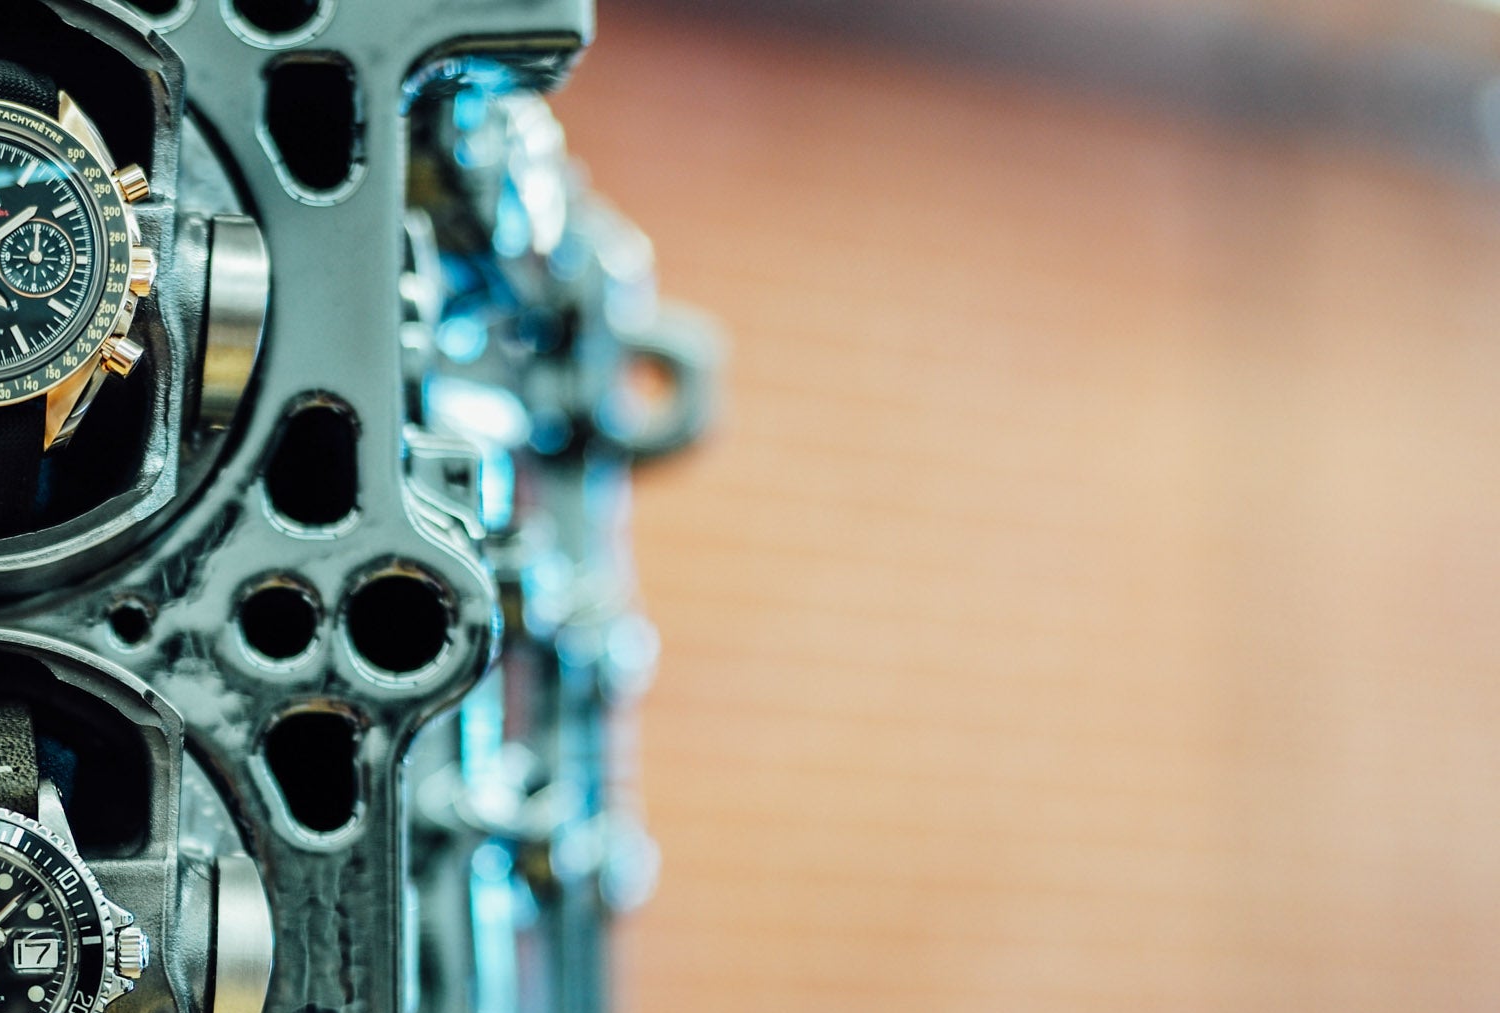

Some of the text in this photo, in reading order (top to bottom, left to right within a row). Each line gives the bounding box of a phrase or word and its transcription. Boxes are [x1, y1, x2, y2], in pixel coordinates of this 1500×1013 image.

[67, 148, 85, 159] 500
[83, 168, 101, 178] 400
[93, 184, 111, 195] 350
[103, 206, 121, 217] 300
[109, 232, 127, 242] 260
[60, 254, 66, 265] 3
[109, 263, 127, 274] 240
[106, 283, 124, 293] 220
[100, 303, 116, 314] 200
[95, 317, 110, 327] 190
[87, 329, 103, 339] 180
[76, 342, 92, 353] 170
[63, 356, 78, 366] 160
[45, 368, 61, 379] 150
[23, 380, 39, 390] 140
[59, 866, 81, 890] 10
[18, 943, 51, 965] 17
